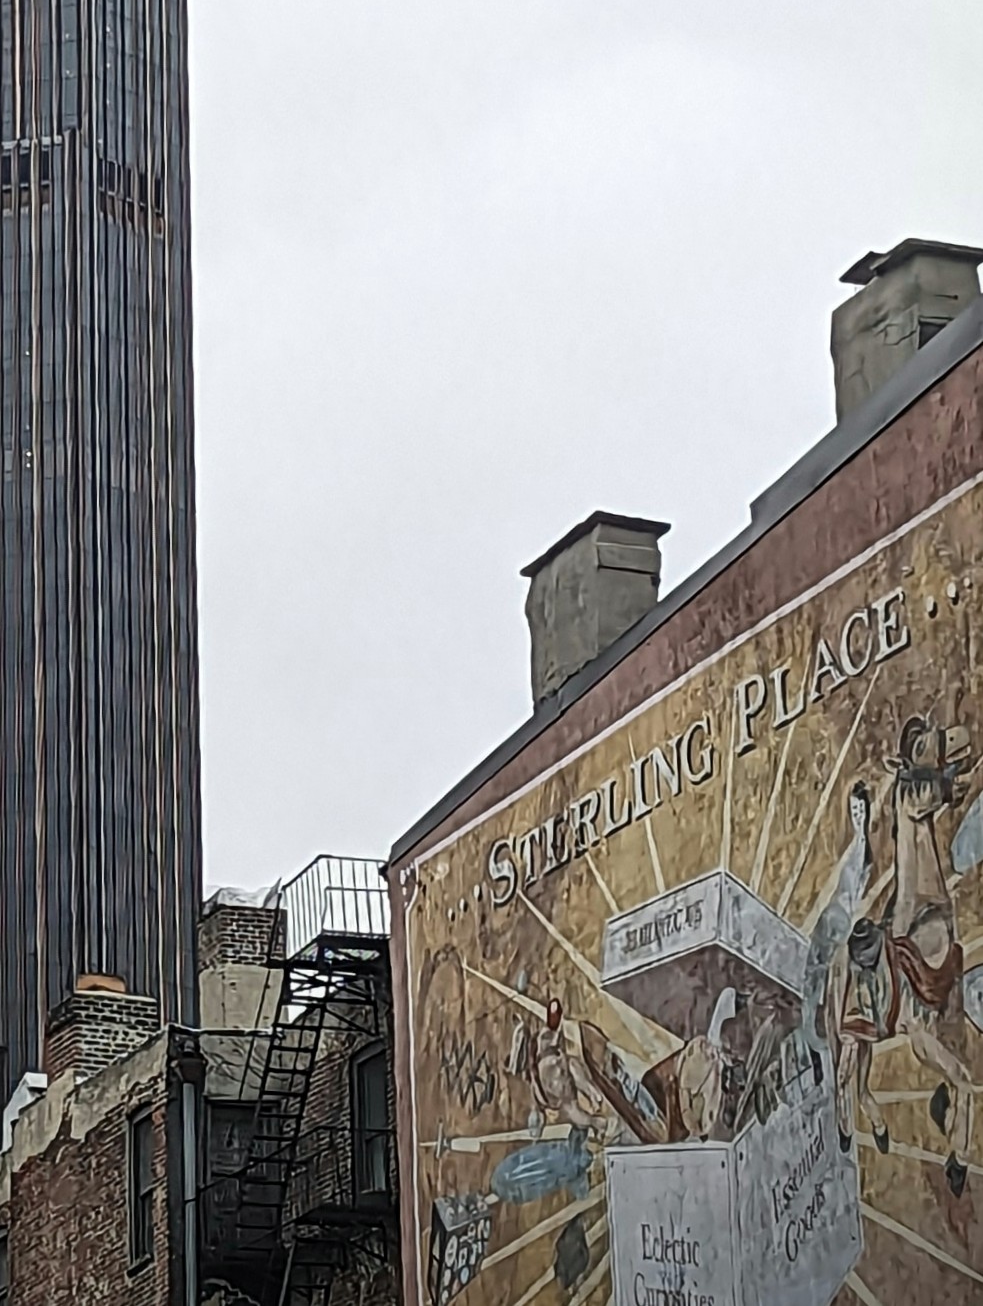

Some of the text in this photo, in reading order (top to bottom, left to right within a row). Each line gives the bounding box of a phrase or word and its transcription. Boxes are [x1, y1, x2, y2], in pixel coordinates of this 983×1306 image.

[487, 587, 913, 906] STERLING PLACE
[641, 1223, 700, 1268] Eclectic
